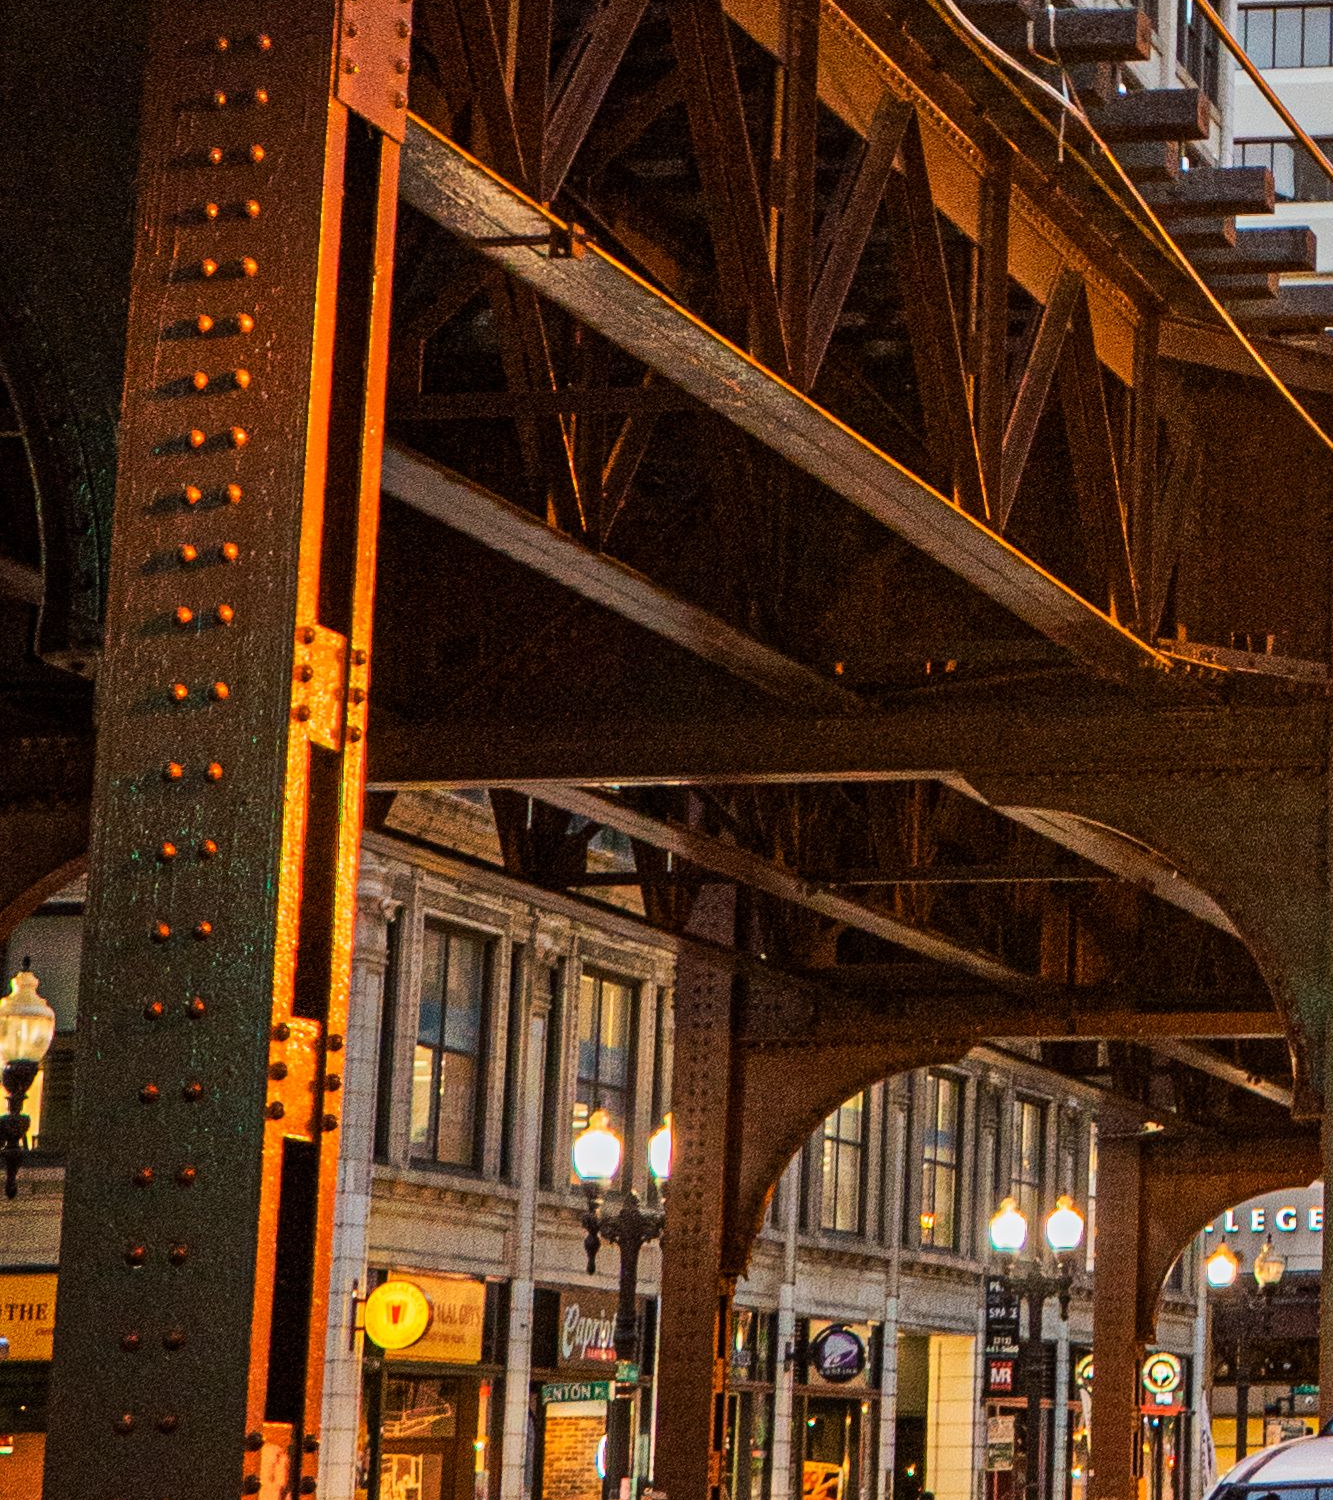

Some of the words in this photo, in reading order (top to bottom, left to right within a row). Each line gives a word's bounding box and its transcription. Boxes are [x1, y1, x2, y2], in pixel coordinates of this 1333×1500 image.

[1204, 1205, 1323, 1232] LEGE
[5, 1303, 48, 1321] THE
[562, 1302, 618, 1360] Capriot
